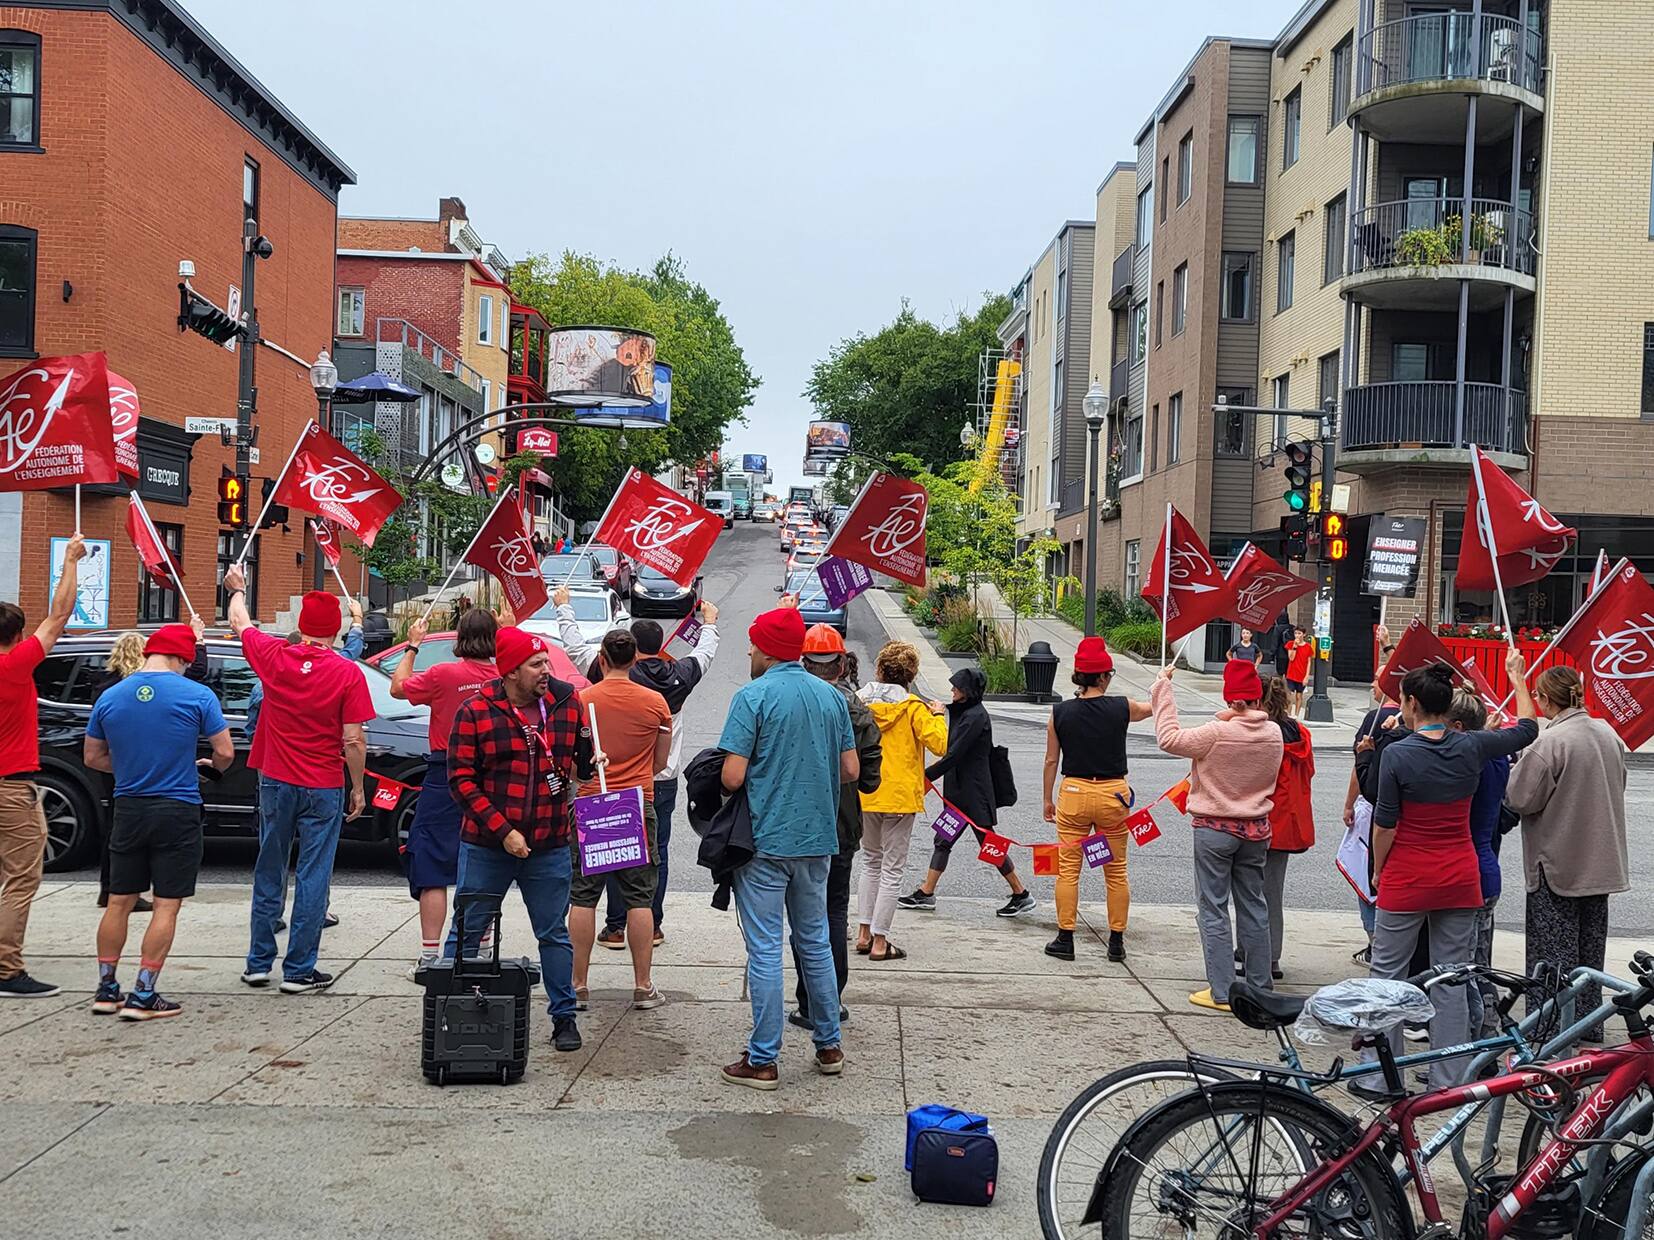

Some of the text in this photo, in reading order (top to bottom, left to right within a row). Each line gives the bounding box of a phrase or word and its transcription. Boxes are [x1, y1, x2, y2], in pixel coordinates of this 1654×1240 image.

[35, 444, 83, 458] FÉDÉRATION
[25, 454, 84, 469] AUTONOME DE
[15, 465, 85, 480] L'ENSEIGNEMENT
[1375, 537, 1417, 550] ENSEIGNER
[1370, 551, 1417, 564] PROFESSION
[1373, 563, 1410, 576] MENACÉE
[1600, 679, 1637, 721] AUTONOME DE
[1613, 679, 1643, 716] FÉDÉRATION
[584, 836, 639, 854] PROFESSION MENACÉE
[585, 845, 641, 868] ENSEIGNER
[451, 1023, 499, 1034] ION
[1521, 1088, 1614, 1194] TREK
